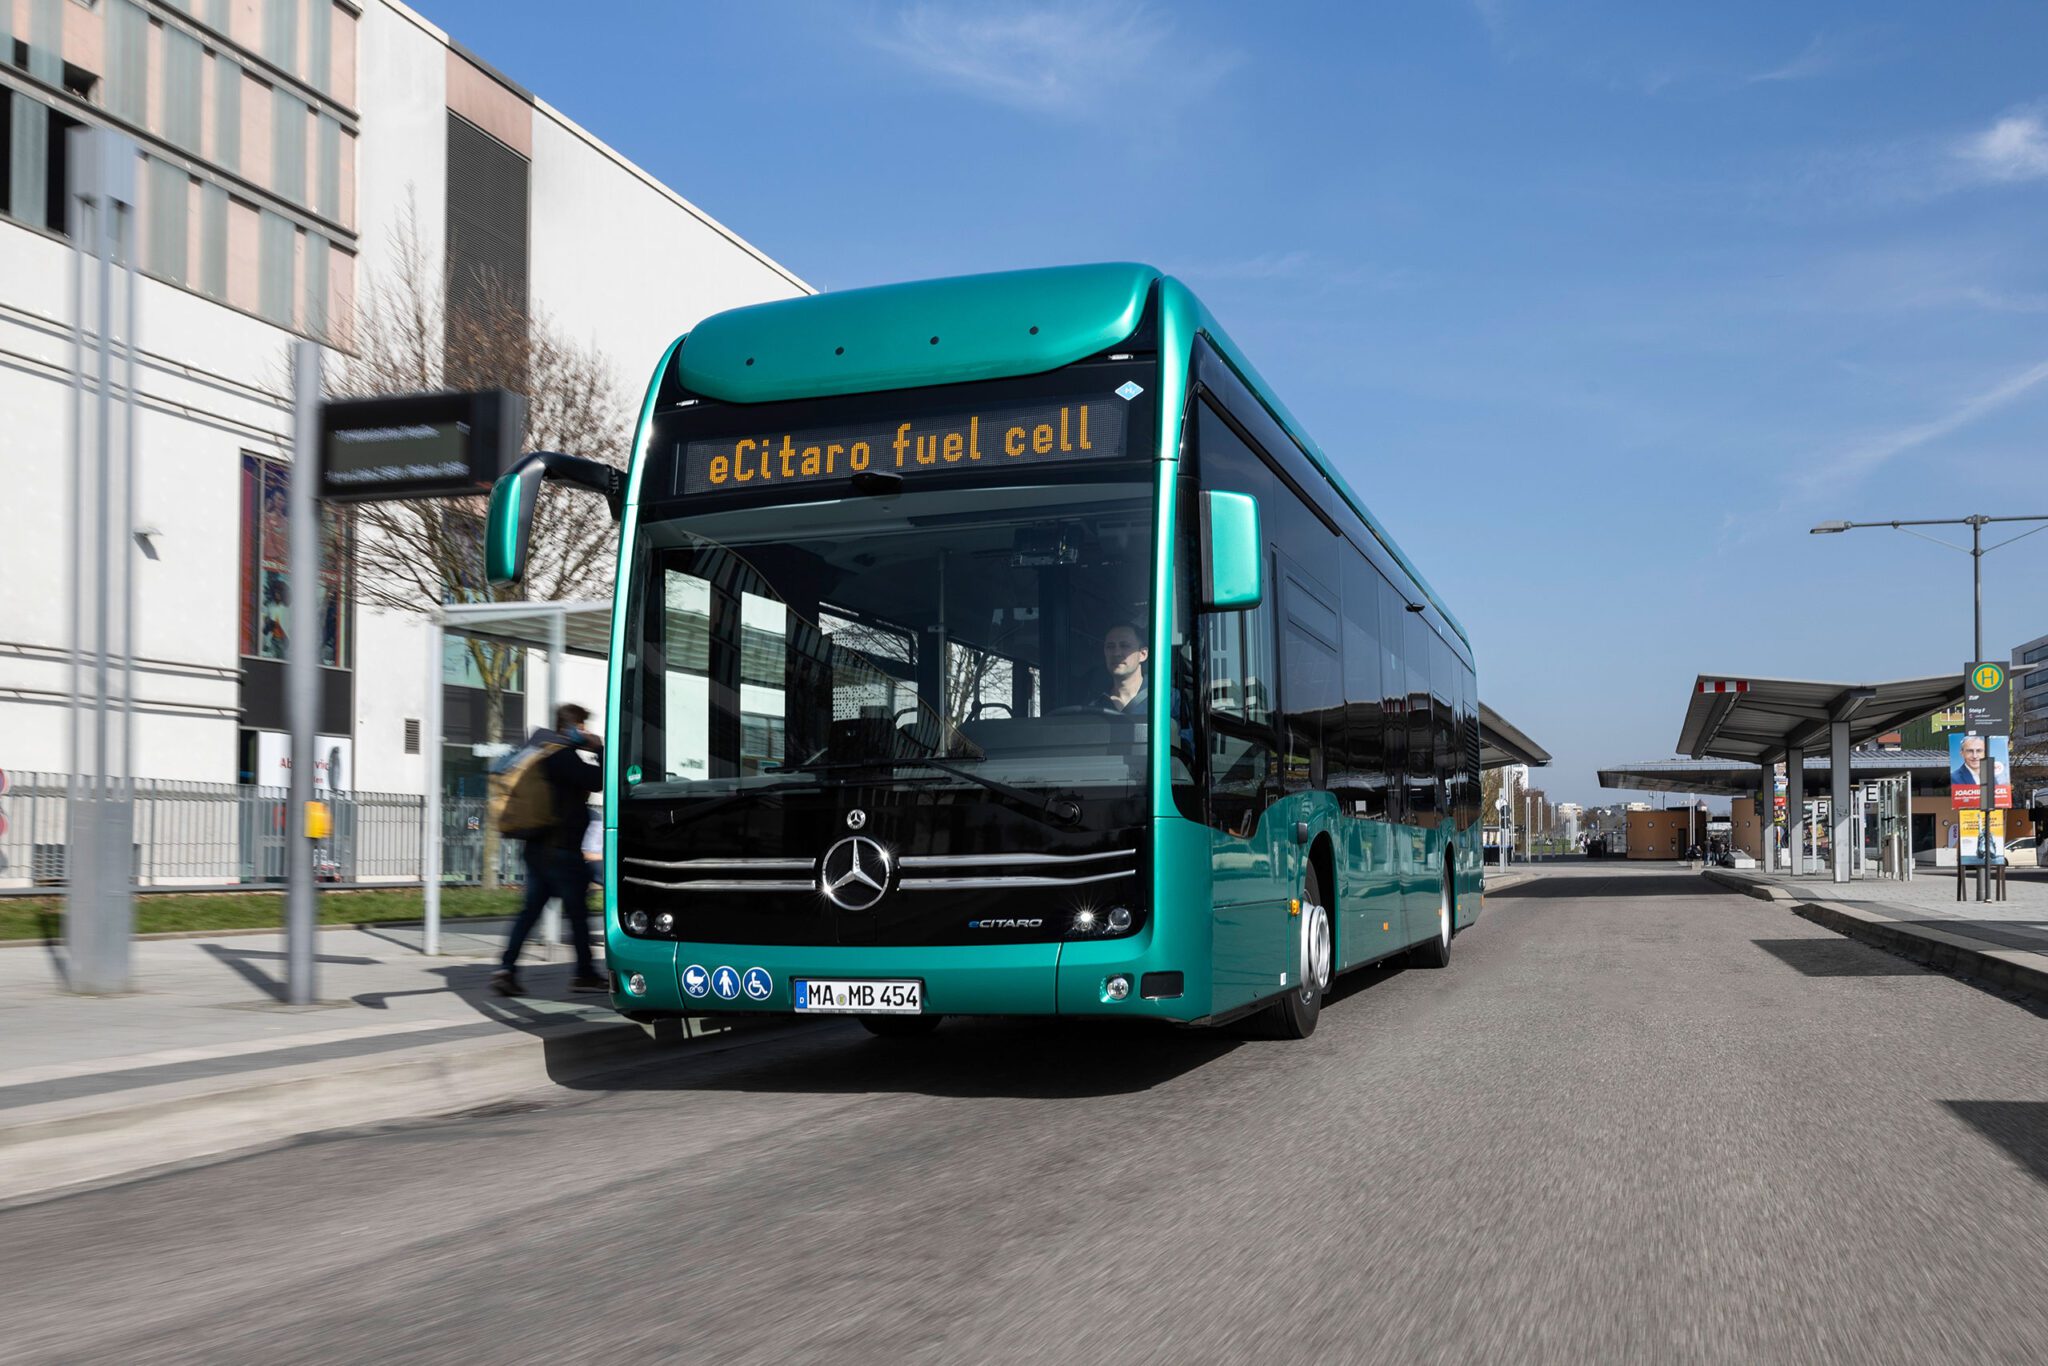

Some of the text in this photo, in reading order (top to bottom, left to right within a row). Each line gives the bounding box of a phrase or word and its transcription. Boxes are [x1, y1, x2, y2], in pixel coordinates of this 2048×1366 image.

[709, 406, 1091, 484] eCitaro fuel cell
[1981, 670, 1995, 686] H
[1866, 785, 1878, 802] E
[1817, 801, 1827, 814] E
[968, 919, 1043, 928] eCITARO
[808, 984, 918, 1007] MA MB 454
